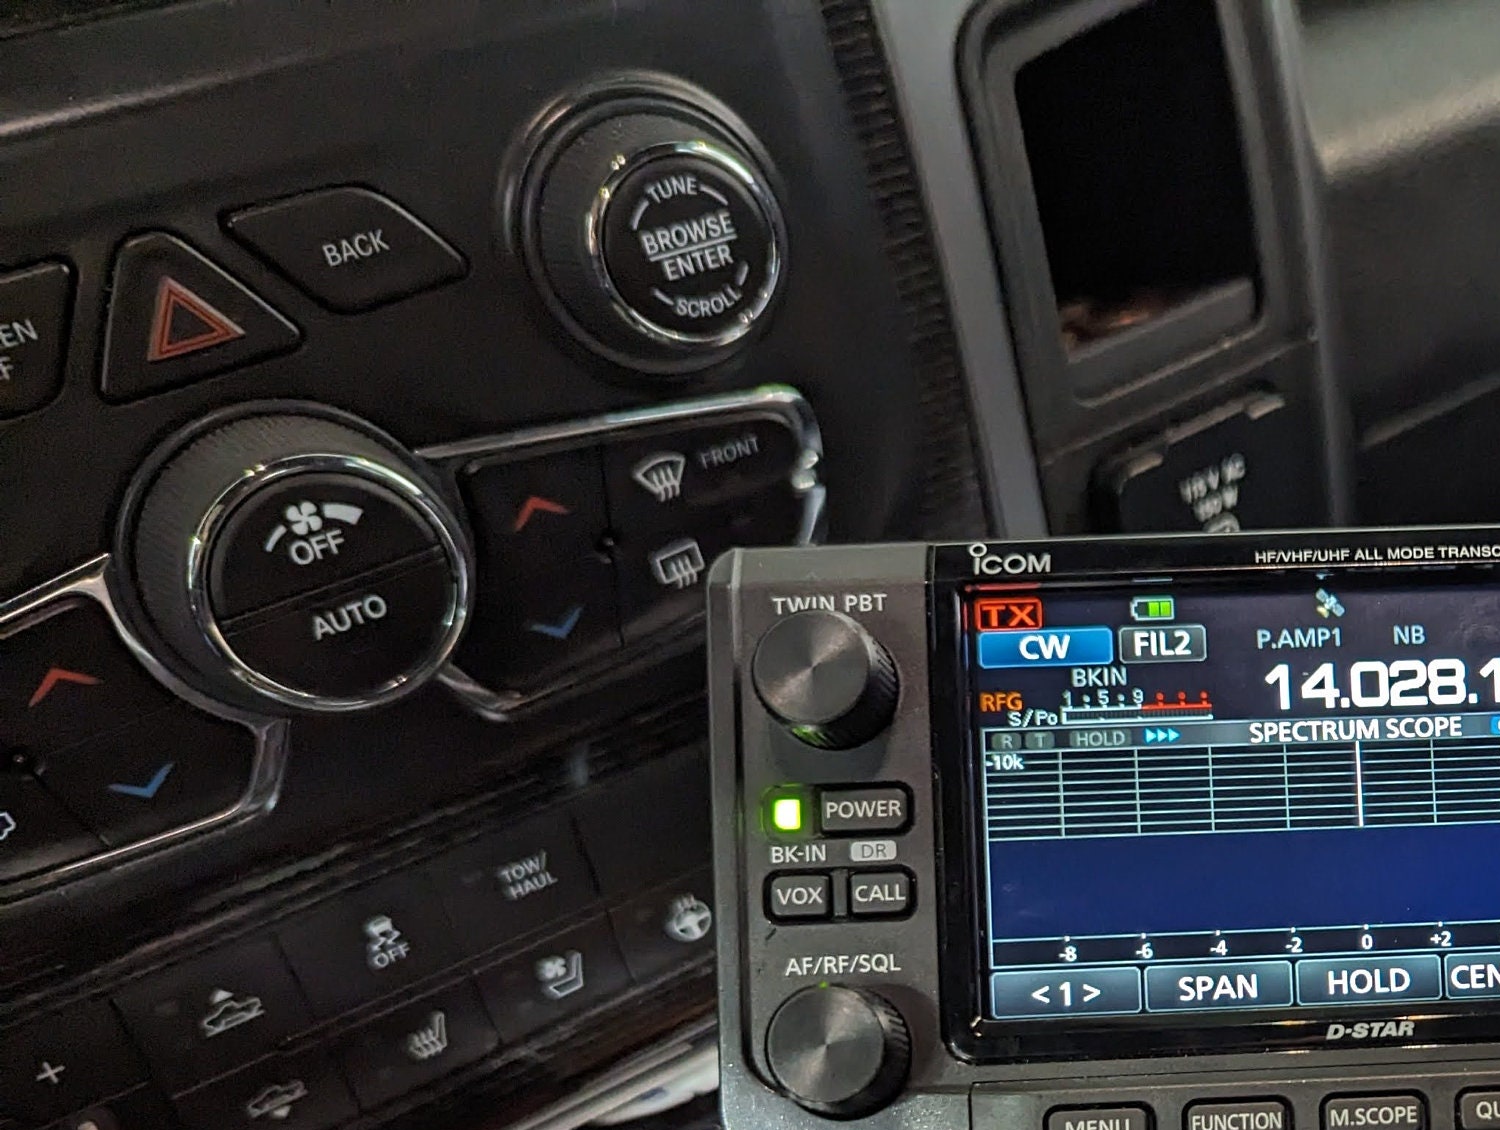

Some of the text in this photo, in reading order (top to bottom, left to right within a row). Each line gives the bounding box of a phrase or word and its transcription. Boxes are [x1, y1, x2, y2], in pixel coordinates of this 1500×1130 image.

[645, 175, 698, 203] TUNE
[640, 208, 736, 255] BROWSE
[322, 227, 389, 267] BACK
[662, 245, 734, 281] ENTER
[676, 283, 743, 319] SCROLL
[699, 435, 760, 469] FRONT
[290, 528, 345, 565] OFF
[1255, 549, 1350, 564] HF/VHF/UHF
[1354, 547, 1383, 561] ALL
[1387, 545, 1434, 559] MODE
[772, 593, 888, 615] TWIN PBT
[980, 604, 1036, 627] TX
[313, 594, 388, 641] AUTO
[1133, 630, 1193, 657] FIL2
[1256, 627, 1341, 649] P.AMP1
[1393, 624, 1426, 645] NB
[1019, 634, 1071, 660] CW
[1071, 666, 1128, 688] BKIN
[980, 692, 1023, 712] RFG
[1007, 708, 1059, 727] S/Po
[1075, 730, 1126, 747] HOLD
[1249, 716, 1463, 744] SPECTRUM SCOPE
[986, 754, 1025, 771] -10k
[825, 800, 902, 820] POWER
[770, 844, 827, 863] BK-IN
[860, 843, 887, 859] DR
[508, 872, 559, 900] HAUL
[777, 886, 824, 905] VOX
[855, 883, 906, 903] CALL
[373, 942, 410, 968] OFF
[1209, 939, 1228, 956] -4
[1285, 937, 1304, 953] -2
[1361, 935, 1373, 950] 0
[1430, 930, 1452, 947] +2
[785, 953, 902, 977] AF/RF/SQL
[1178, 974, 1258, 1001] SPAN
[1328, 967, 1411, 996] HOLD
[1330, 1104, 1418, 1127] M.SCOPE
